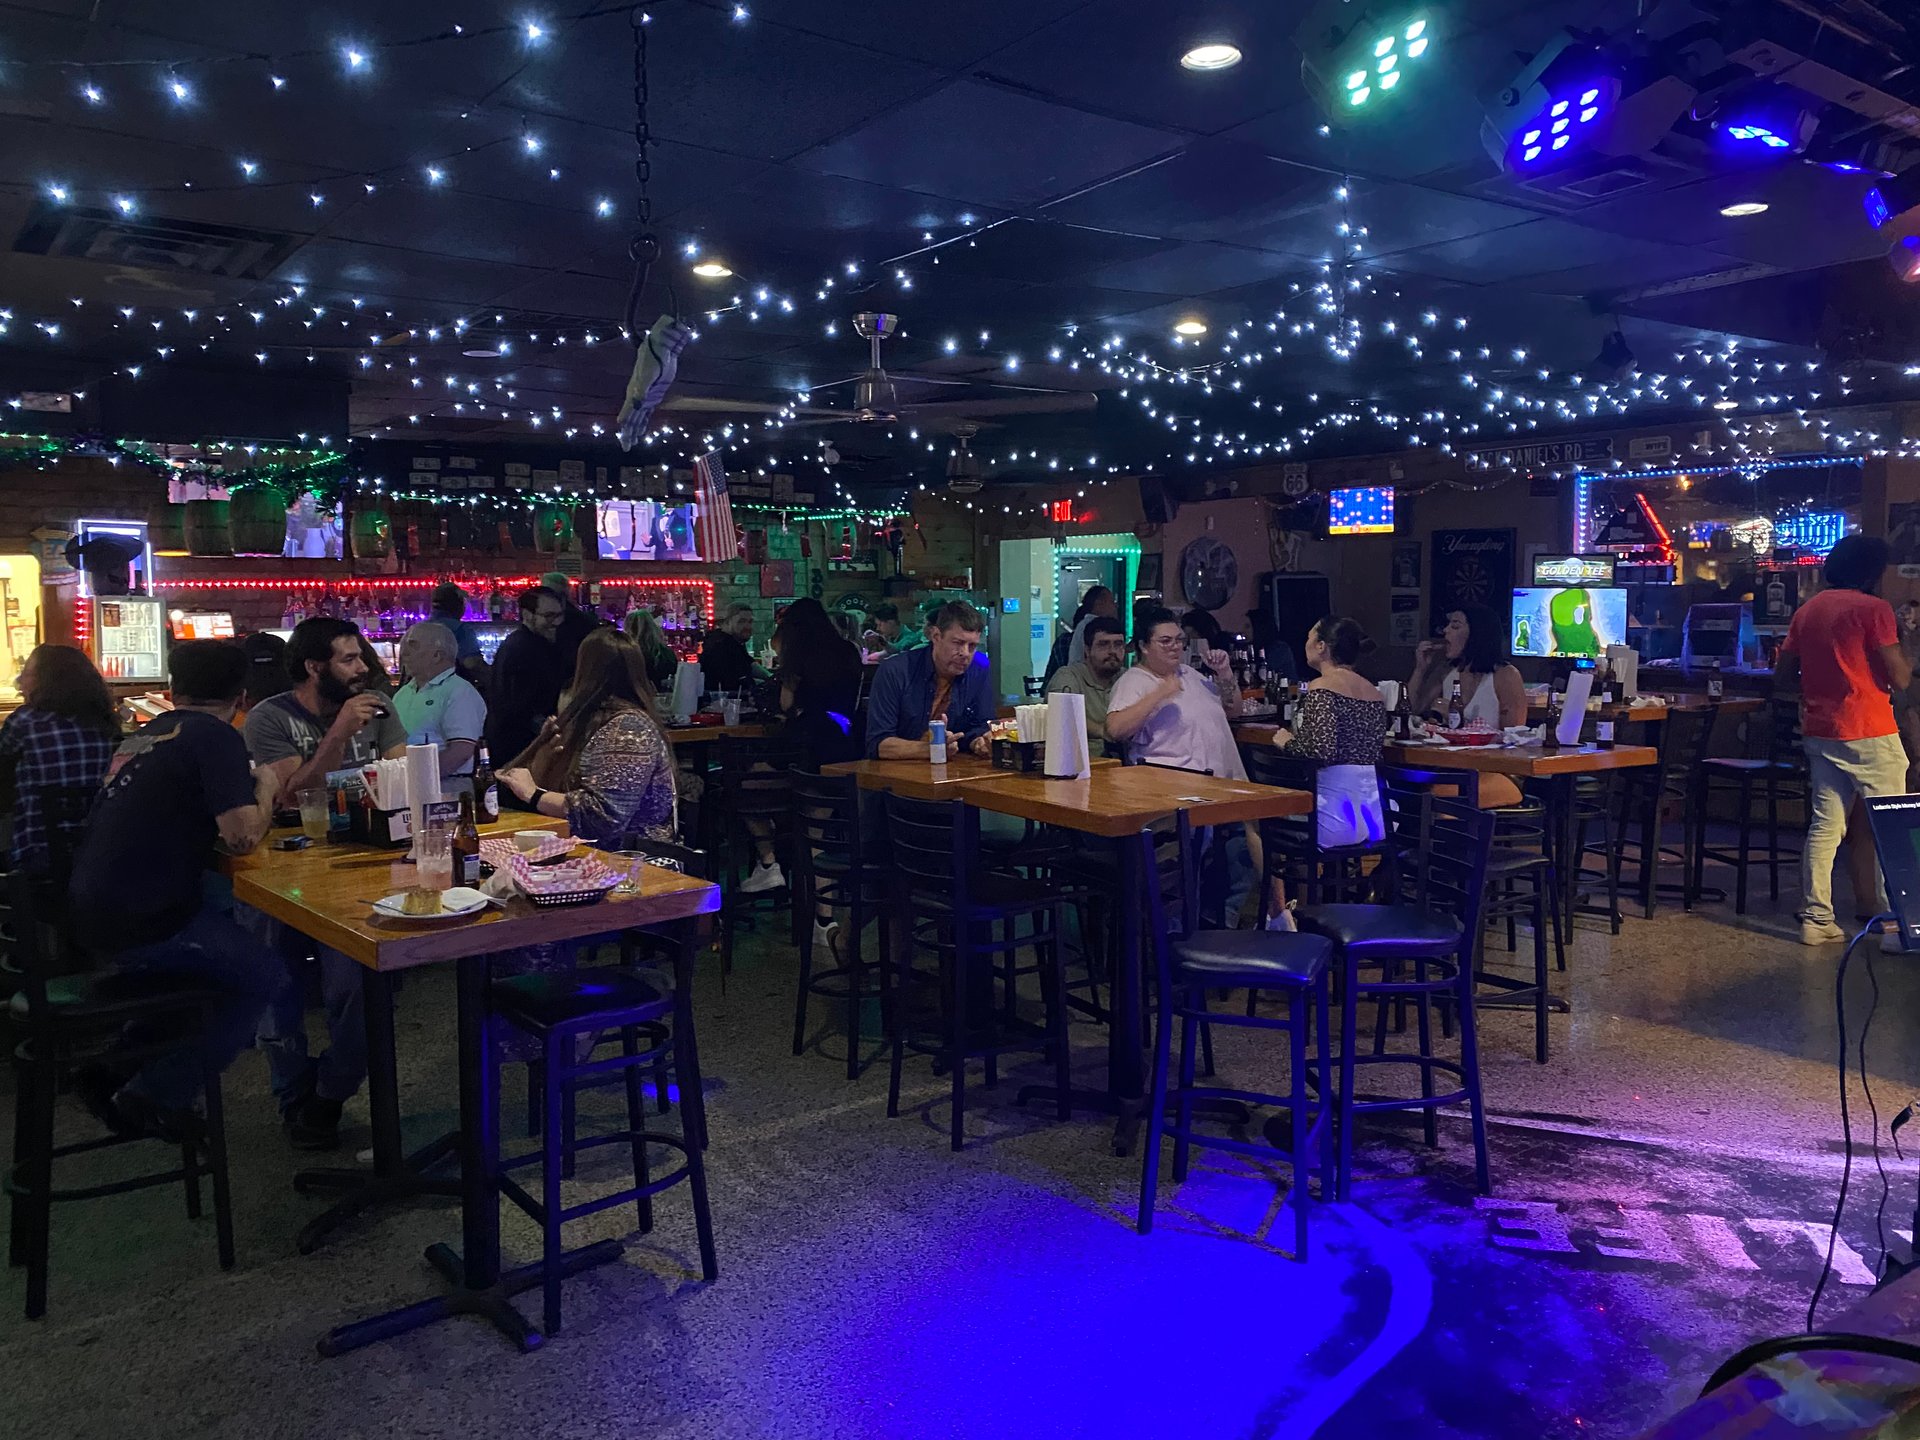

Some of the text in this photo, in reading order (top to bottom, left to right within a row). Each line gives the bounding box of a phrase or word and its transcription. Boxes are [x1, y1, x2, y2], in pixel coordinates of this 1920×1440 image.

[1564, 442, 1583, 461] RD
[1286, 476, 1306, 492] 66
[1052, 501, 1072, 522] EXIT
[1541, 565, 1606, 577] GOLDEN TEE
